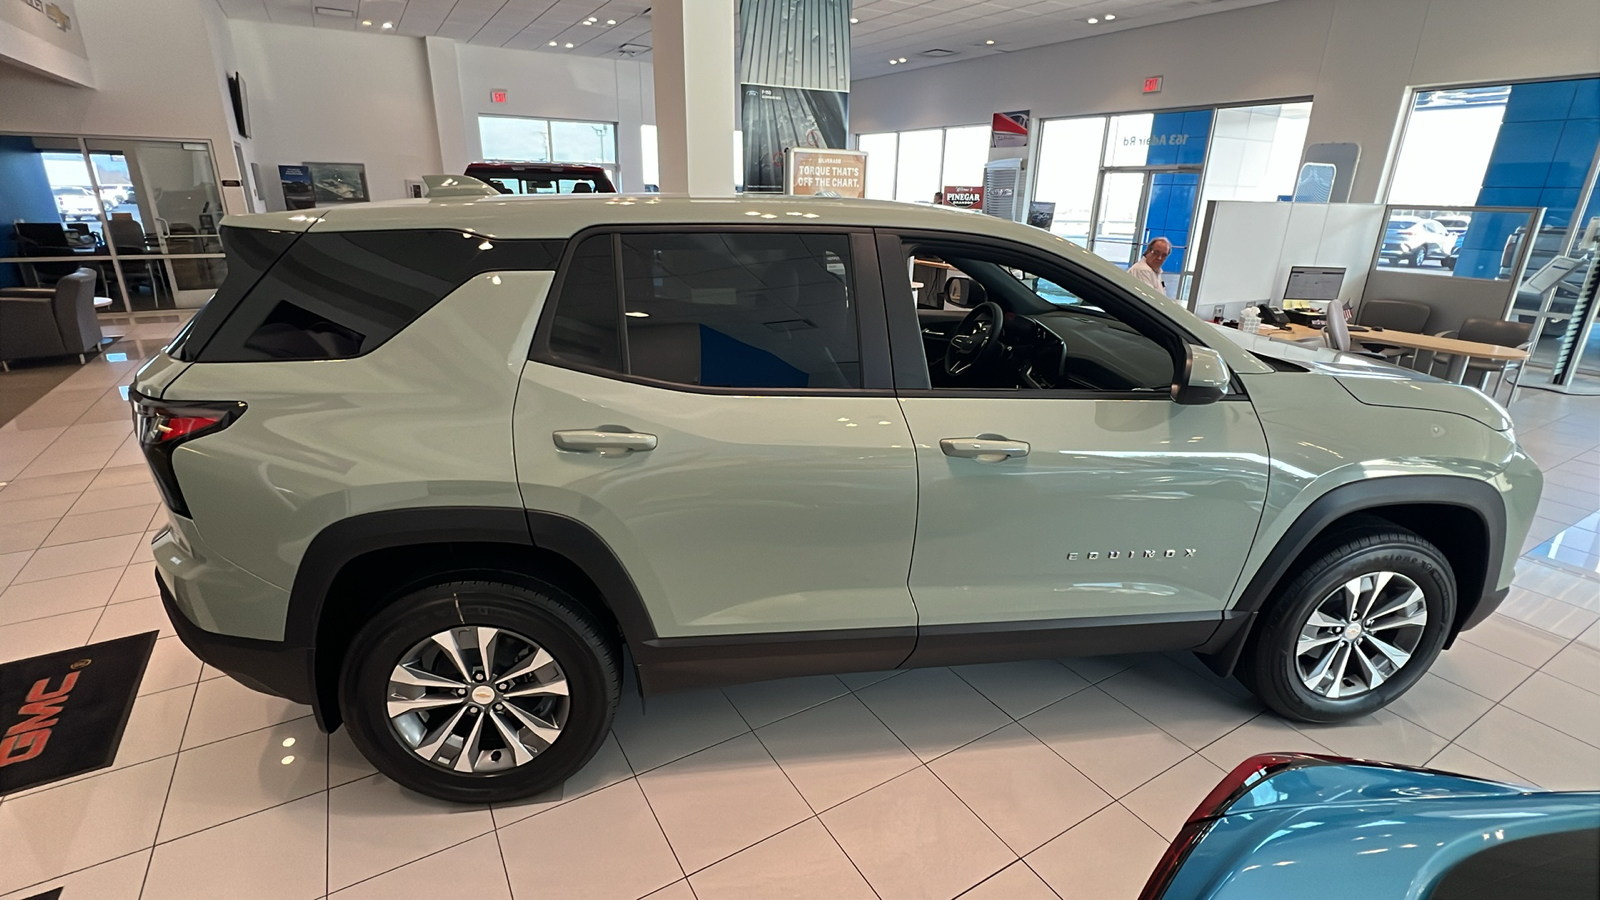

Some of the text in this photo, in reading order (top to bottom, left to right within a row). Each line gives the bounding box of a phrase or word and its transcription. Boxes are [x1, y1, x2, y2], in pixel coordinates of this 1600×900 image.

[1144, 78, 1158, 91] EXIT
[494, 92, 506, 102] EXIT
[799, 165, 859, 177] TORQUE THAT'S
[797, 177, 860, 188] OFF THE CHART.
[946, 193, 980, 201] PINEGAR
[1067, 548, 1197, 560] EQUINOX
[0, 670, 81, 767] GMC
